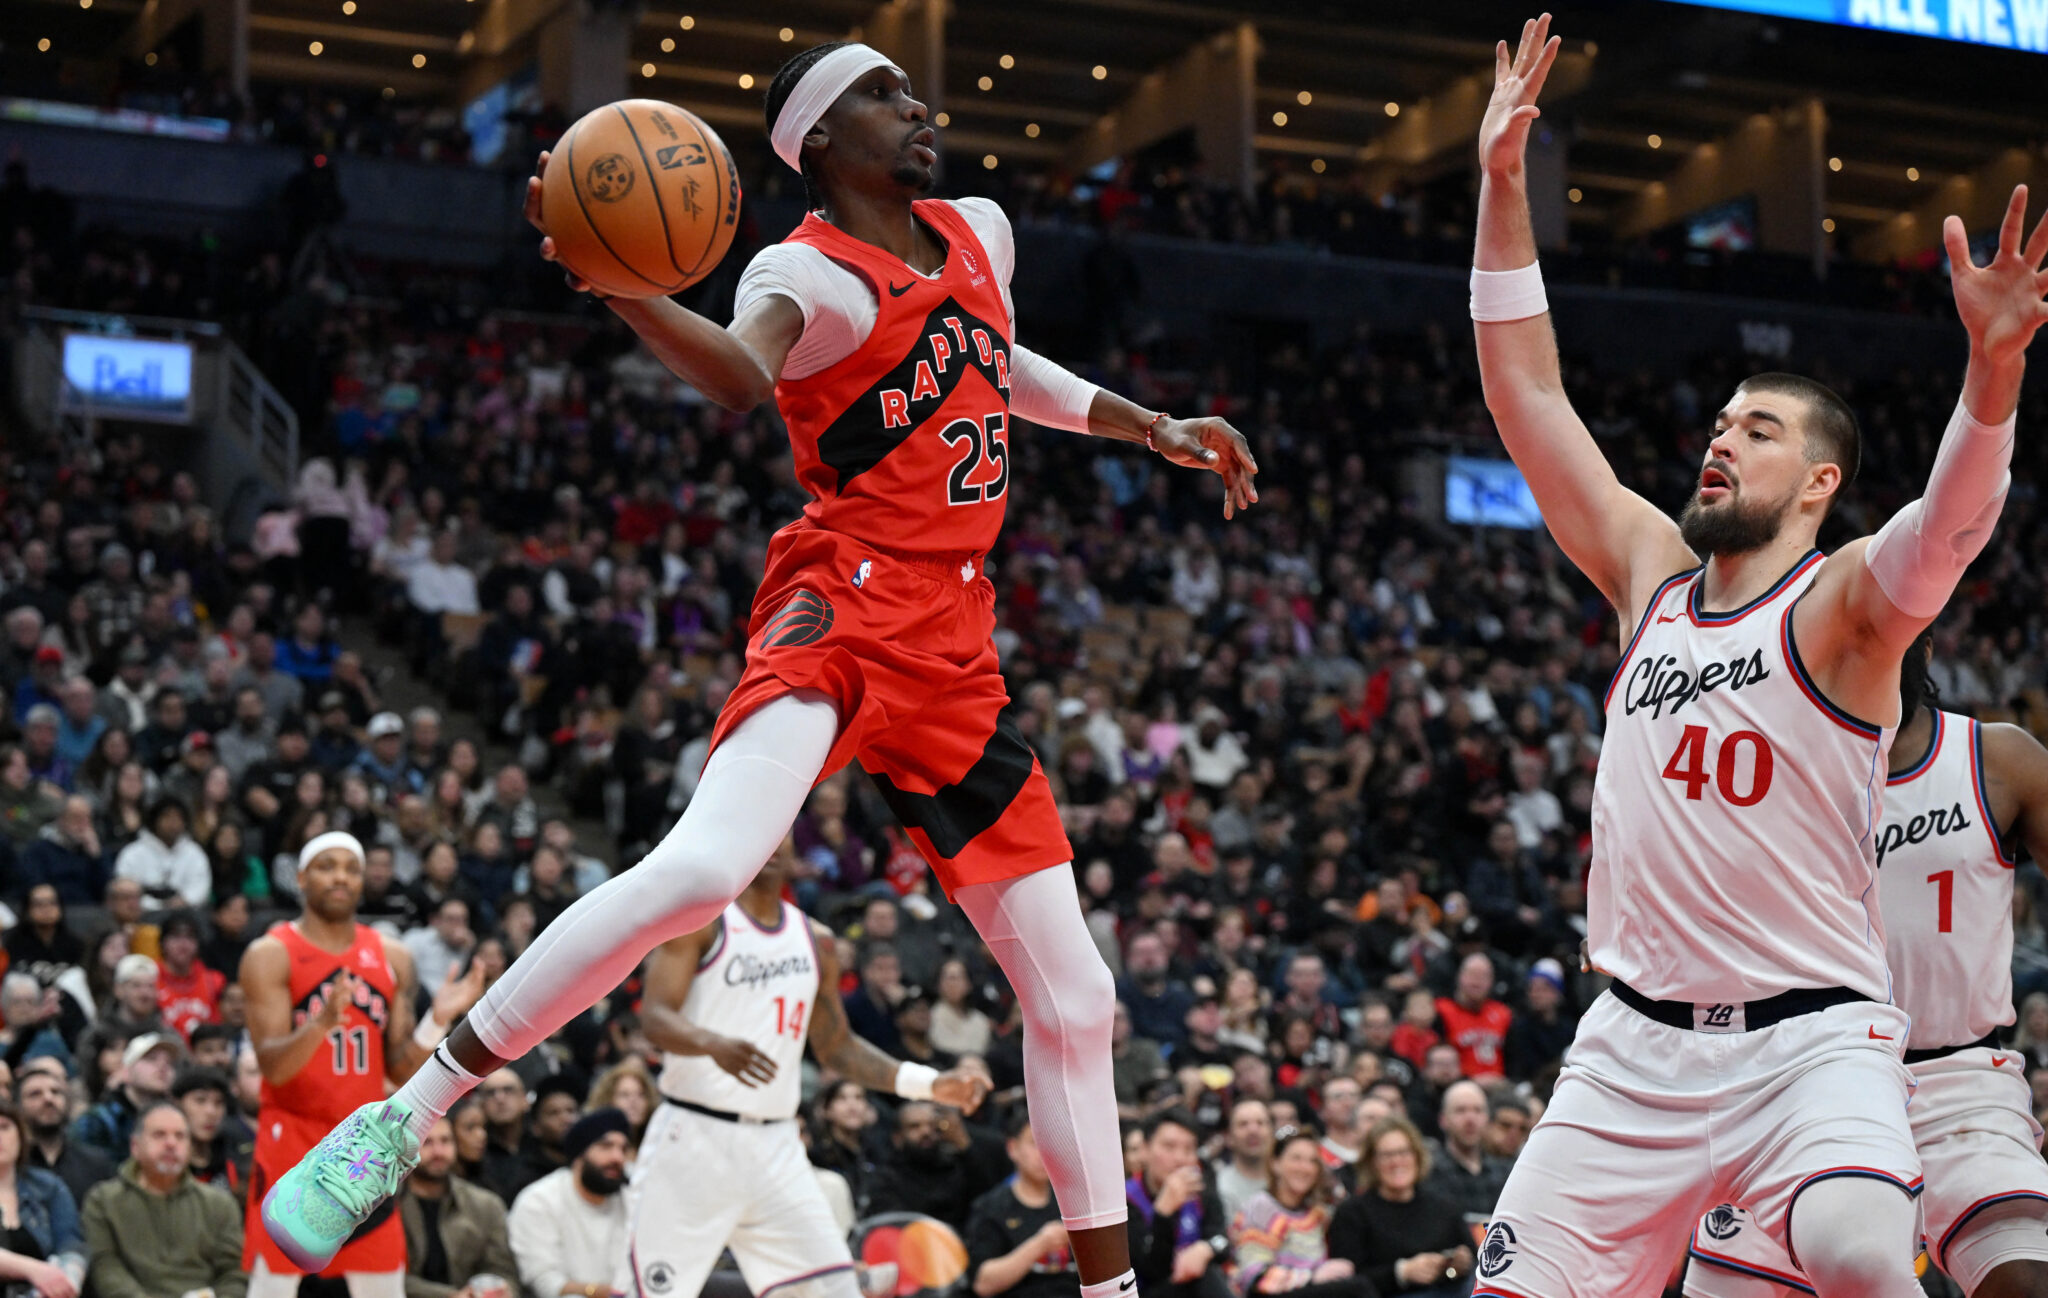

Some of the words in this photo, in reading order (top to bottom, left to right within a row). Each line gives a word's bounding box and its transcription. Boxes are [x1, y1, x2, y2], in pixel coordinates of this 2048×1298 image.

[1850, 0, 1939, 35] ALL
[1948, 0, 2048, 53] NEW
[879, 317, 1010, 429] RAPTOR
[939, 411, 1009, 506] 25
[1625, 648, 1770, 720] Clippers
[1662, 724, 1774, 807] 40
[1875, 802, 1971, 868] pers
[1927, 870, 1954, 933] 1
[724, 952, 811, 990] Clippers
[327, 1024, 370, 1076] 11
[773, 996, 806, 1040] 14
